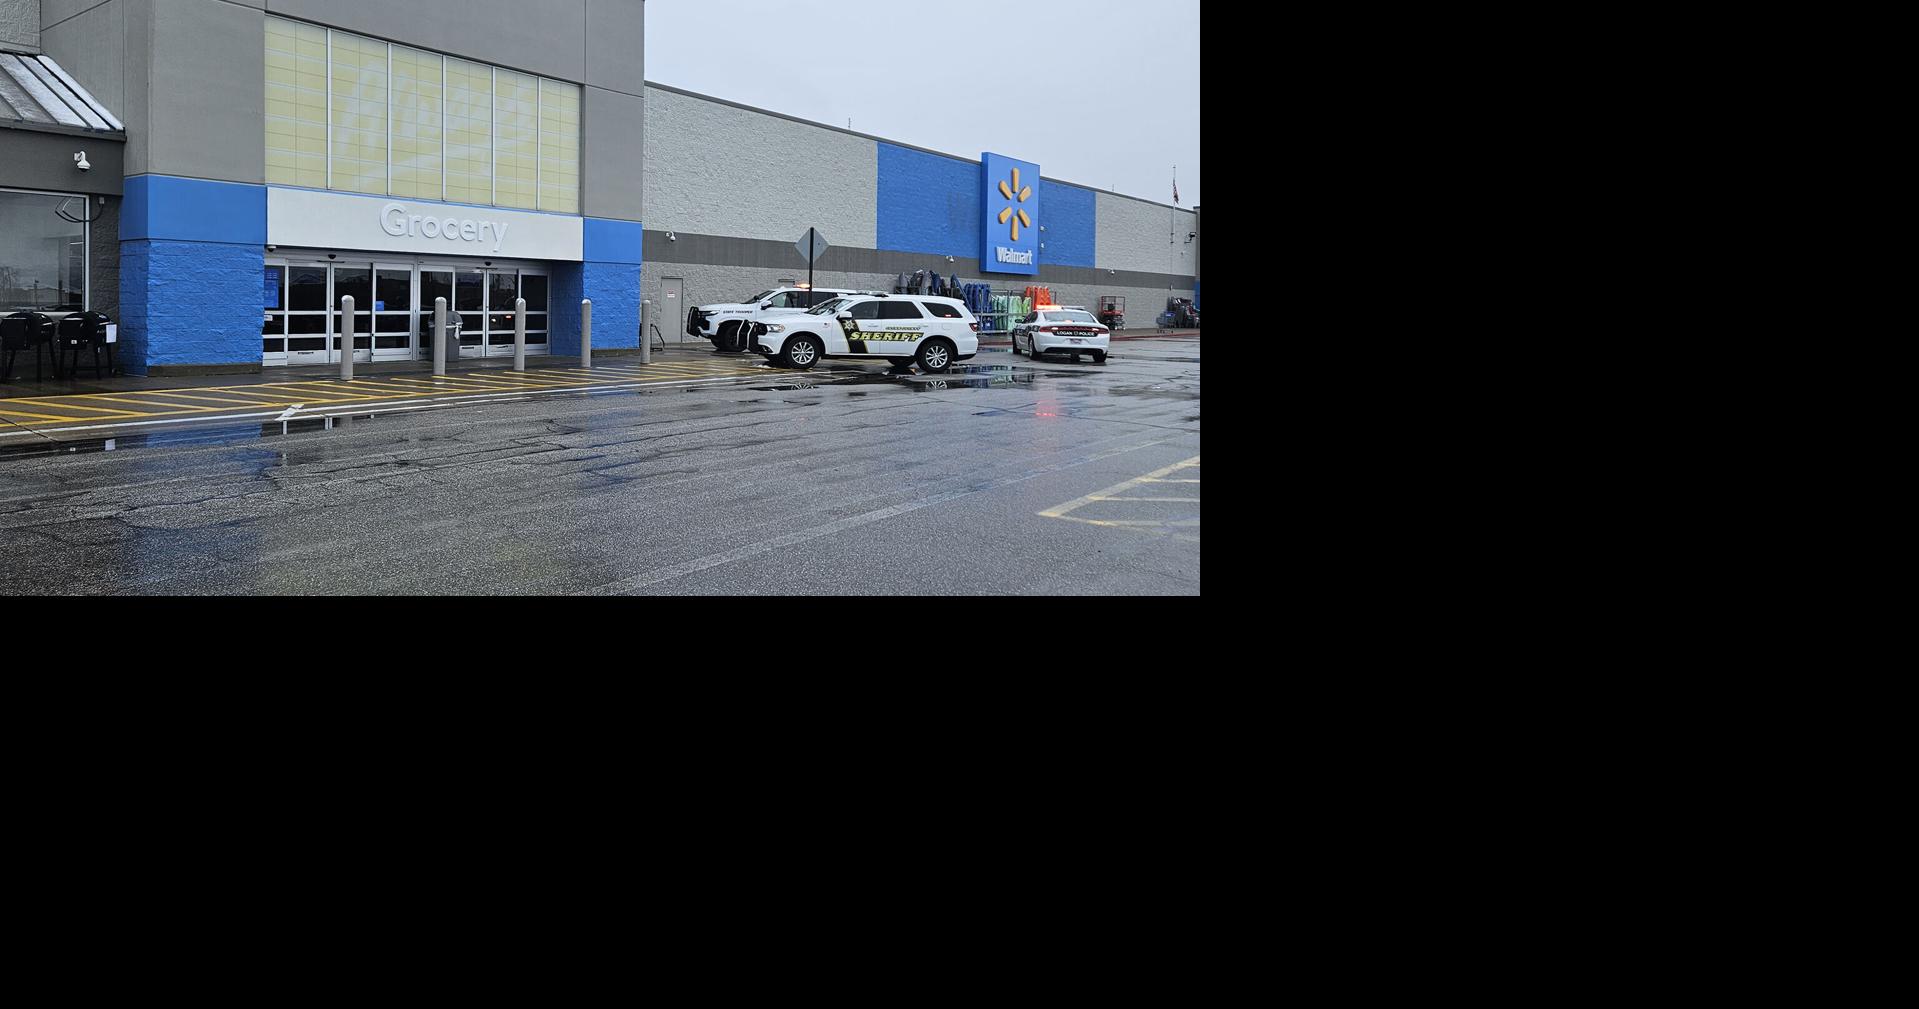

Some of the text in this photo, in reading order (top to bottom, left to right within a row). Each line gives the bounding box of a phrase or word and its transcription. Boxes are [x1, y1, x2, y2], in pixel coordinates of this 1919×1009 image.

[380, 202, 508, 252] Grocery
[995, 246, 1032, 265] Walmart
[850, 331, 924, 342] SHERIFF
